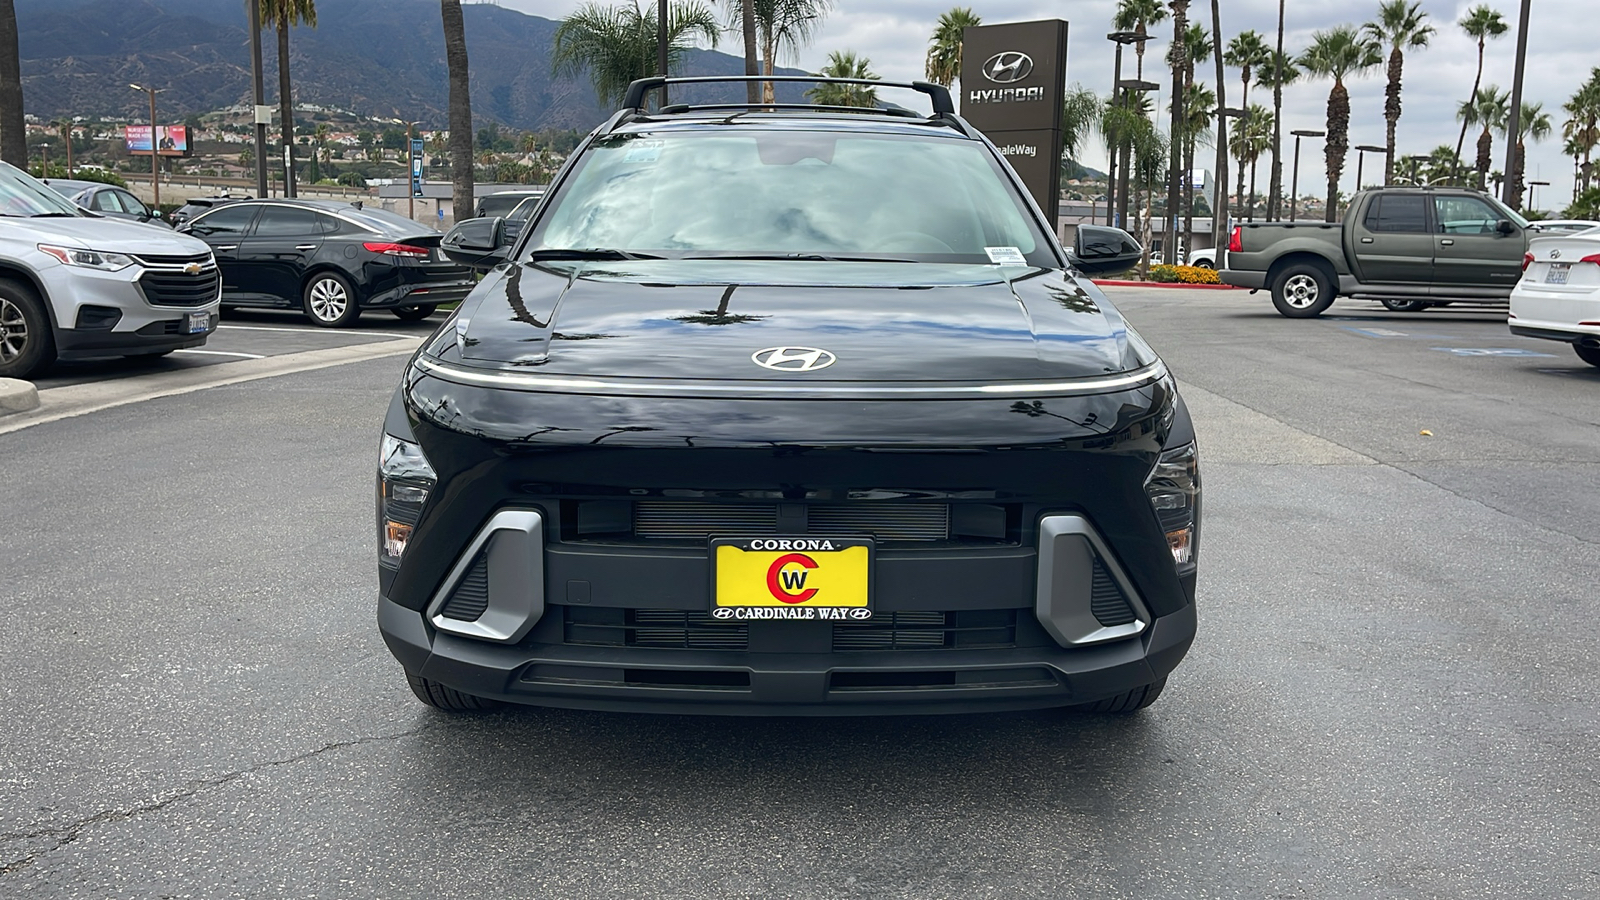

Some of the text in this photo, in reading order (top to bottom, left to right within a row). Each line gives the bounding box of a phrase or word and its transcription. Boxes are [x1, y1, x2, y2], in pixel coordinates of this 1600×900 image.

[970, 86, 1044, 104] HYUNDAI
[750, 539, 834, 551] CORONA
[735, 607, 850, 620] CARDINALE WAY
